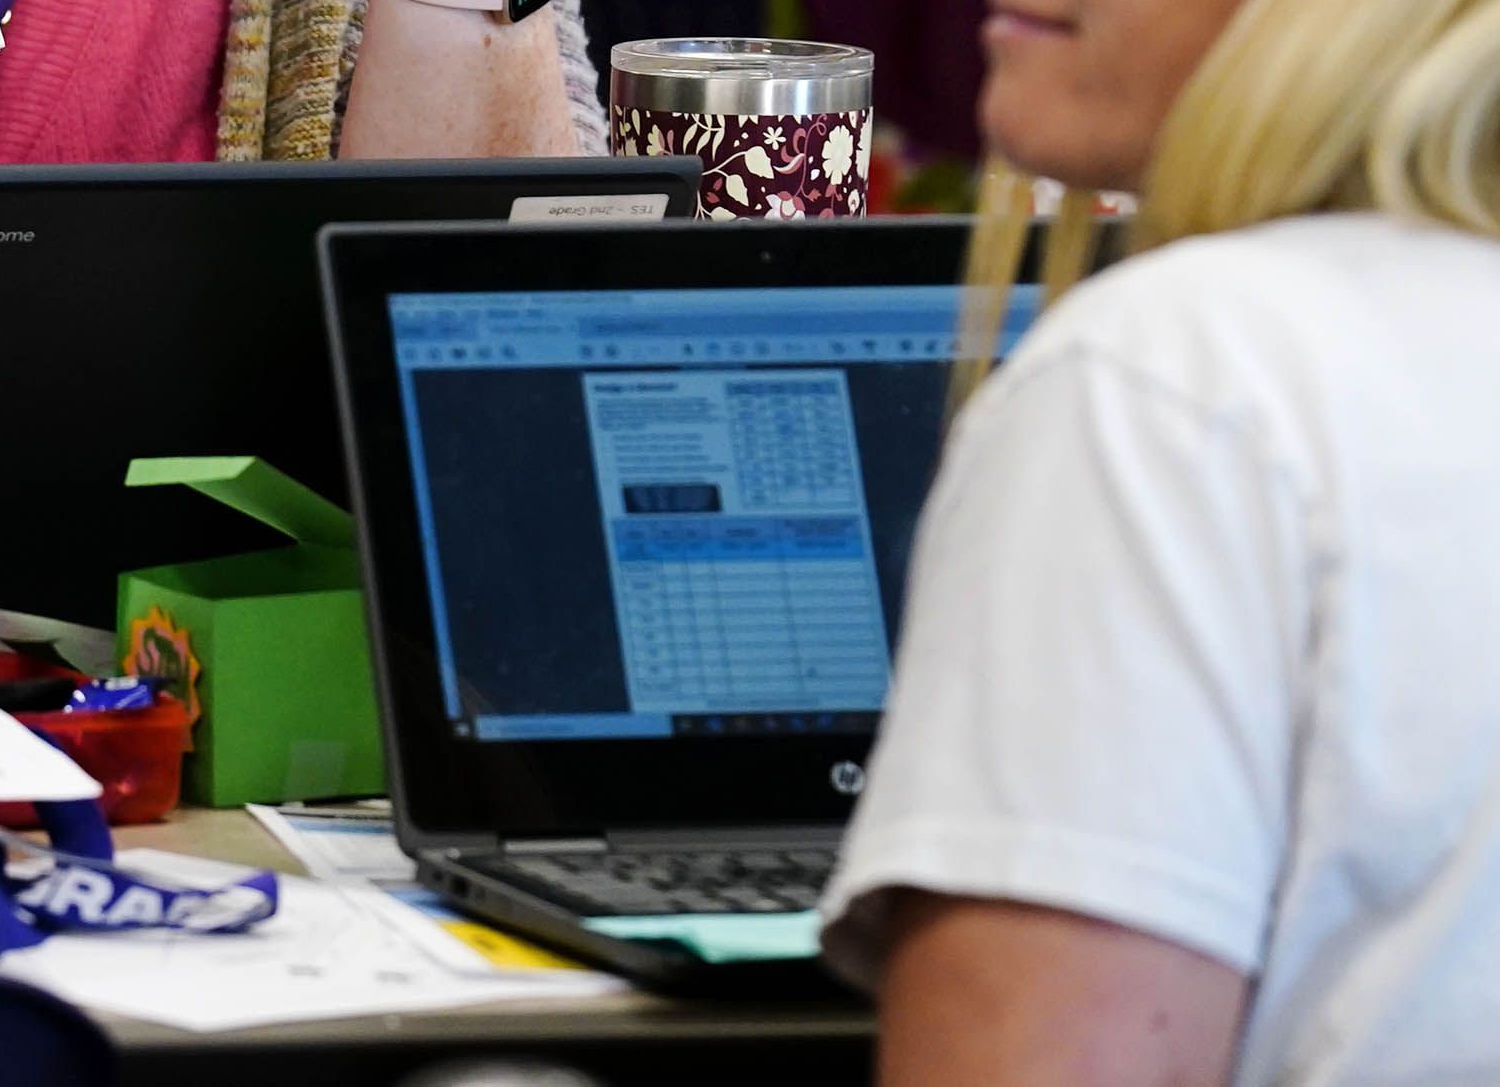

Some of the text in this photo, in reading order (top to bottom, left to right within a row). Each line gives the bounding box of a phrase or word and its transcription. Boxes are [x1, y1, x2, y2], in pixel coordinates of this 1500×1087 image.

[549, 205, 586, 217] Grade
[589, 205, 612, 216] 2nd
[631, 204, 653, 215] TES
